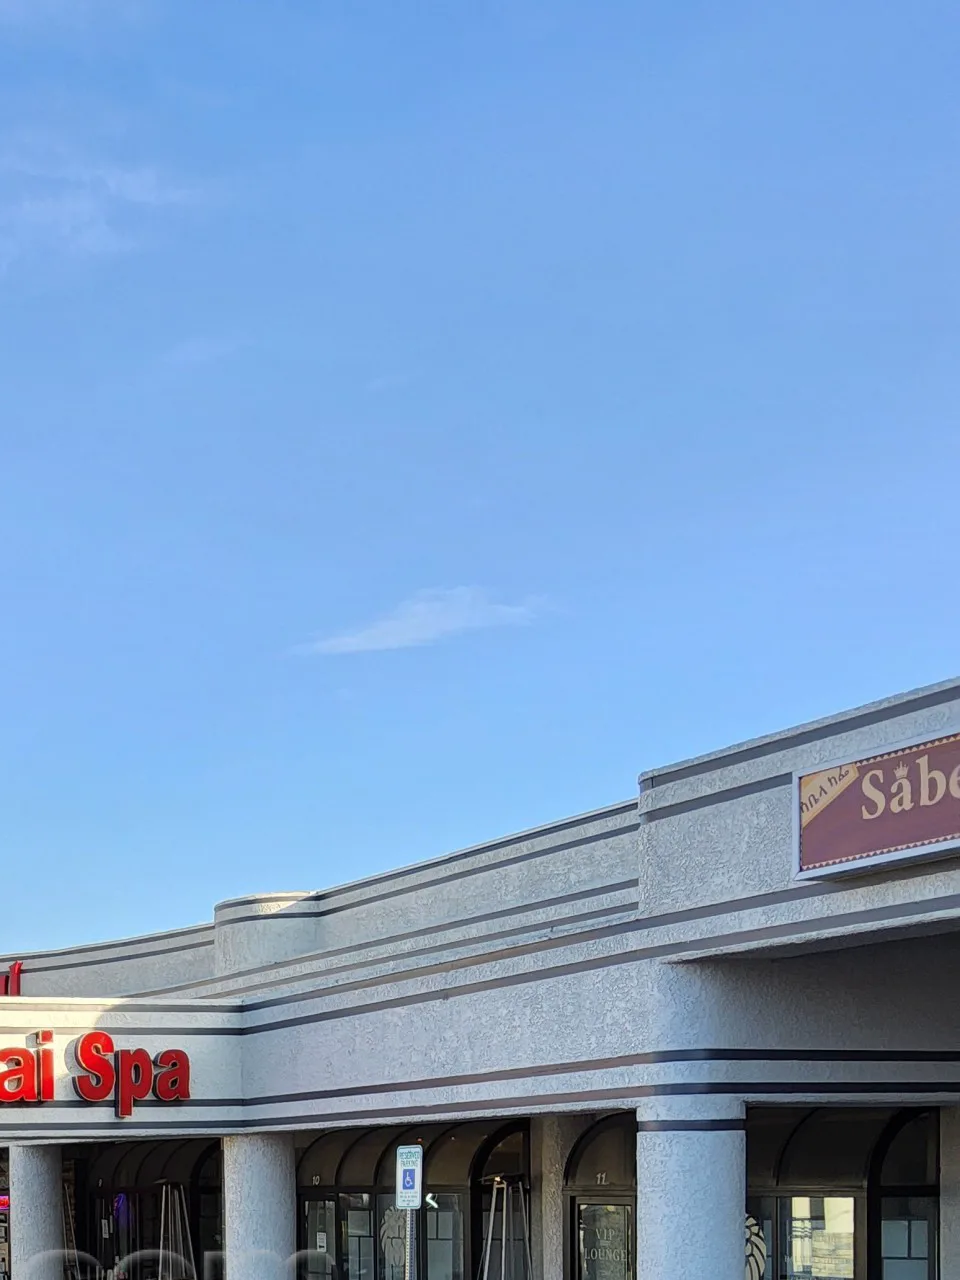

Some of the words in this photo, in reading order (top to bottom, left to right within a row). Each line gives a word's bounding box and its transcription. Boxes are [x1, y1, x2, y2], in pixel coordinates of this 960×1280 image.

[73, 1030, 192, 1119] Spa
[595, 1227, 616, 1241] VIP
[584, 1248, 628, 1262] LOUNGE
